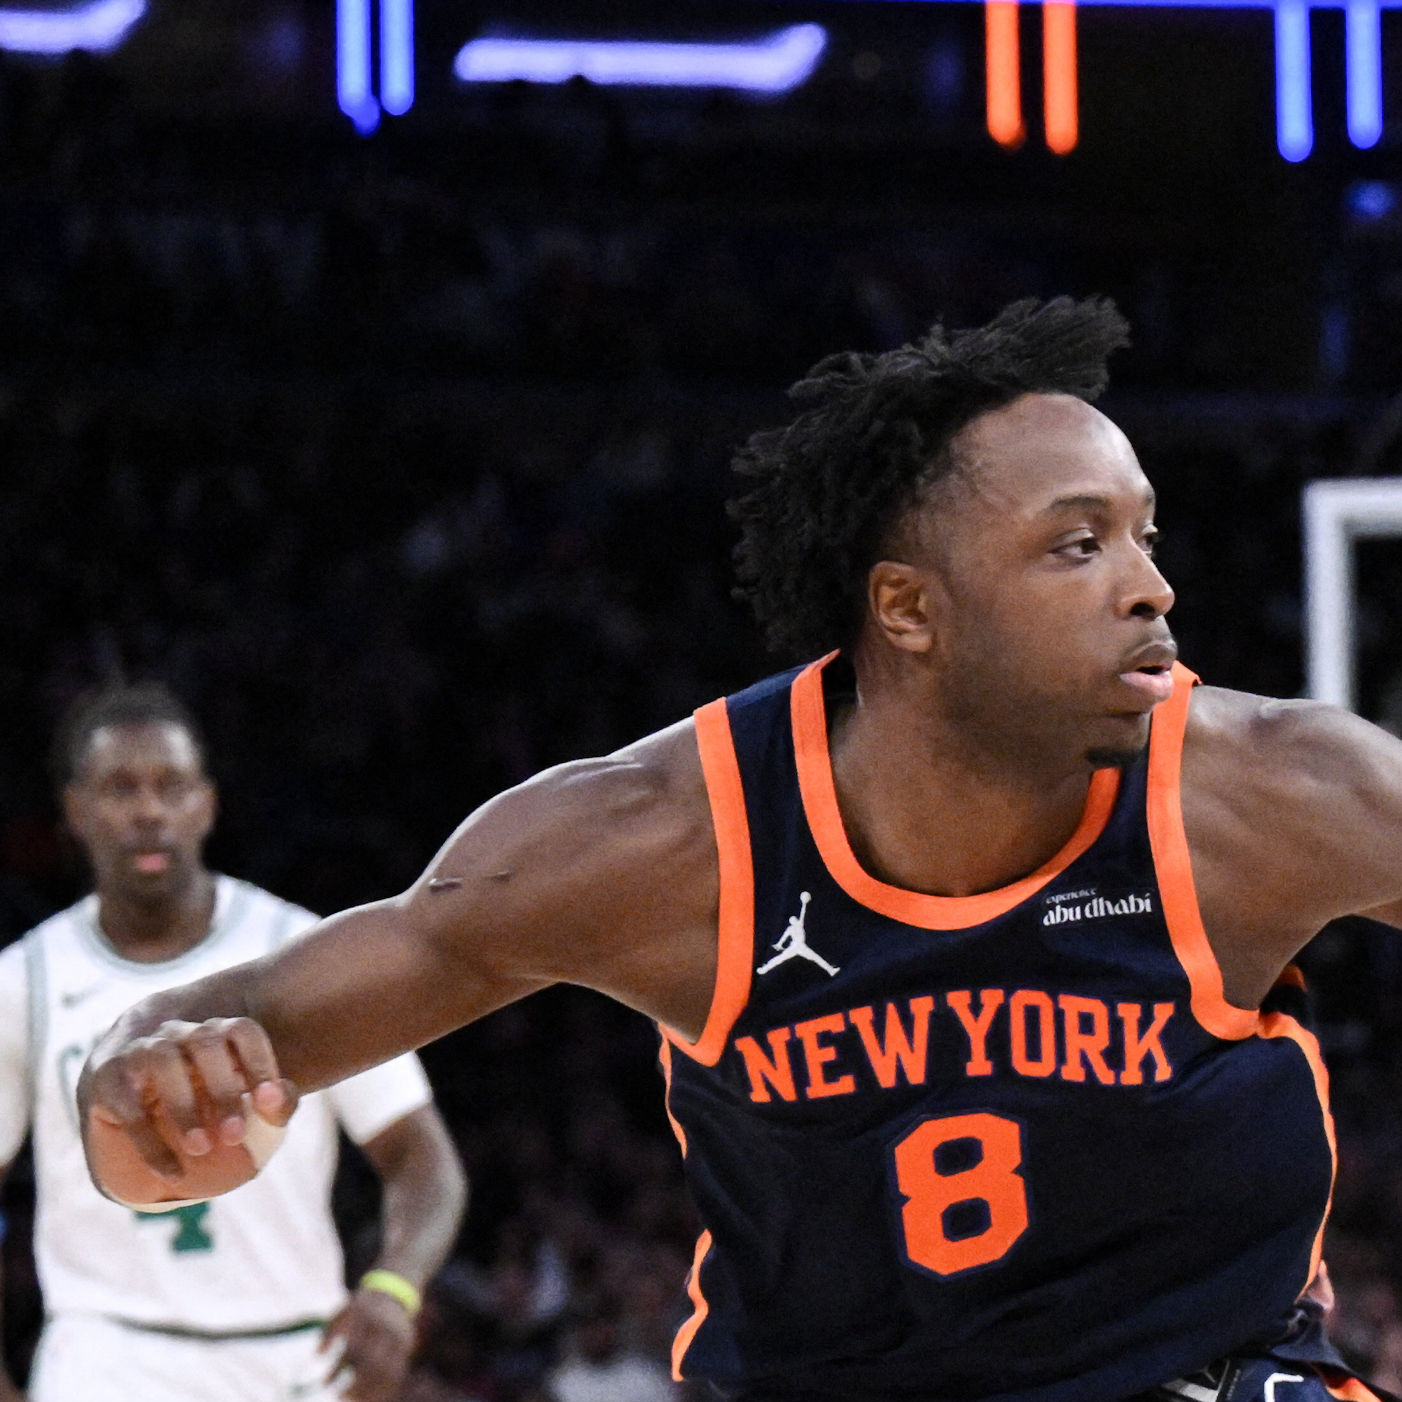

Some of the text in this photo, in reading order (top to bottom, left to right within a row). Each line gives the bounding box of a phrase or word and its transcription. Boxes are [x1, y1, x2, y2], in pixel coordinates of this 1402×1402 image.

[1043, 893, 1153, 927] abu dhabi
[735, 988, 1176, 1104] NEW YORK
[892, 1111, 1031, 1277] 8
